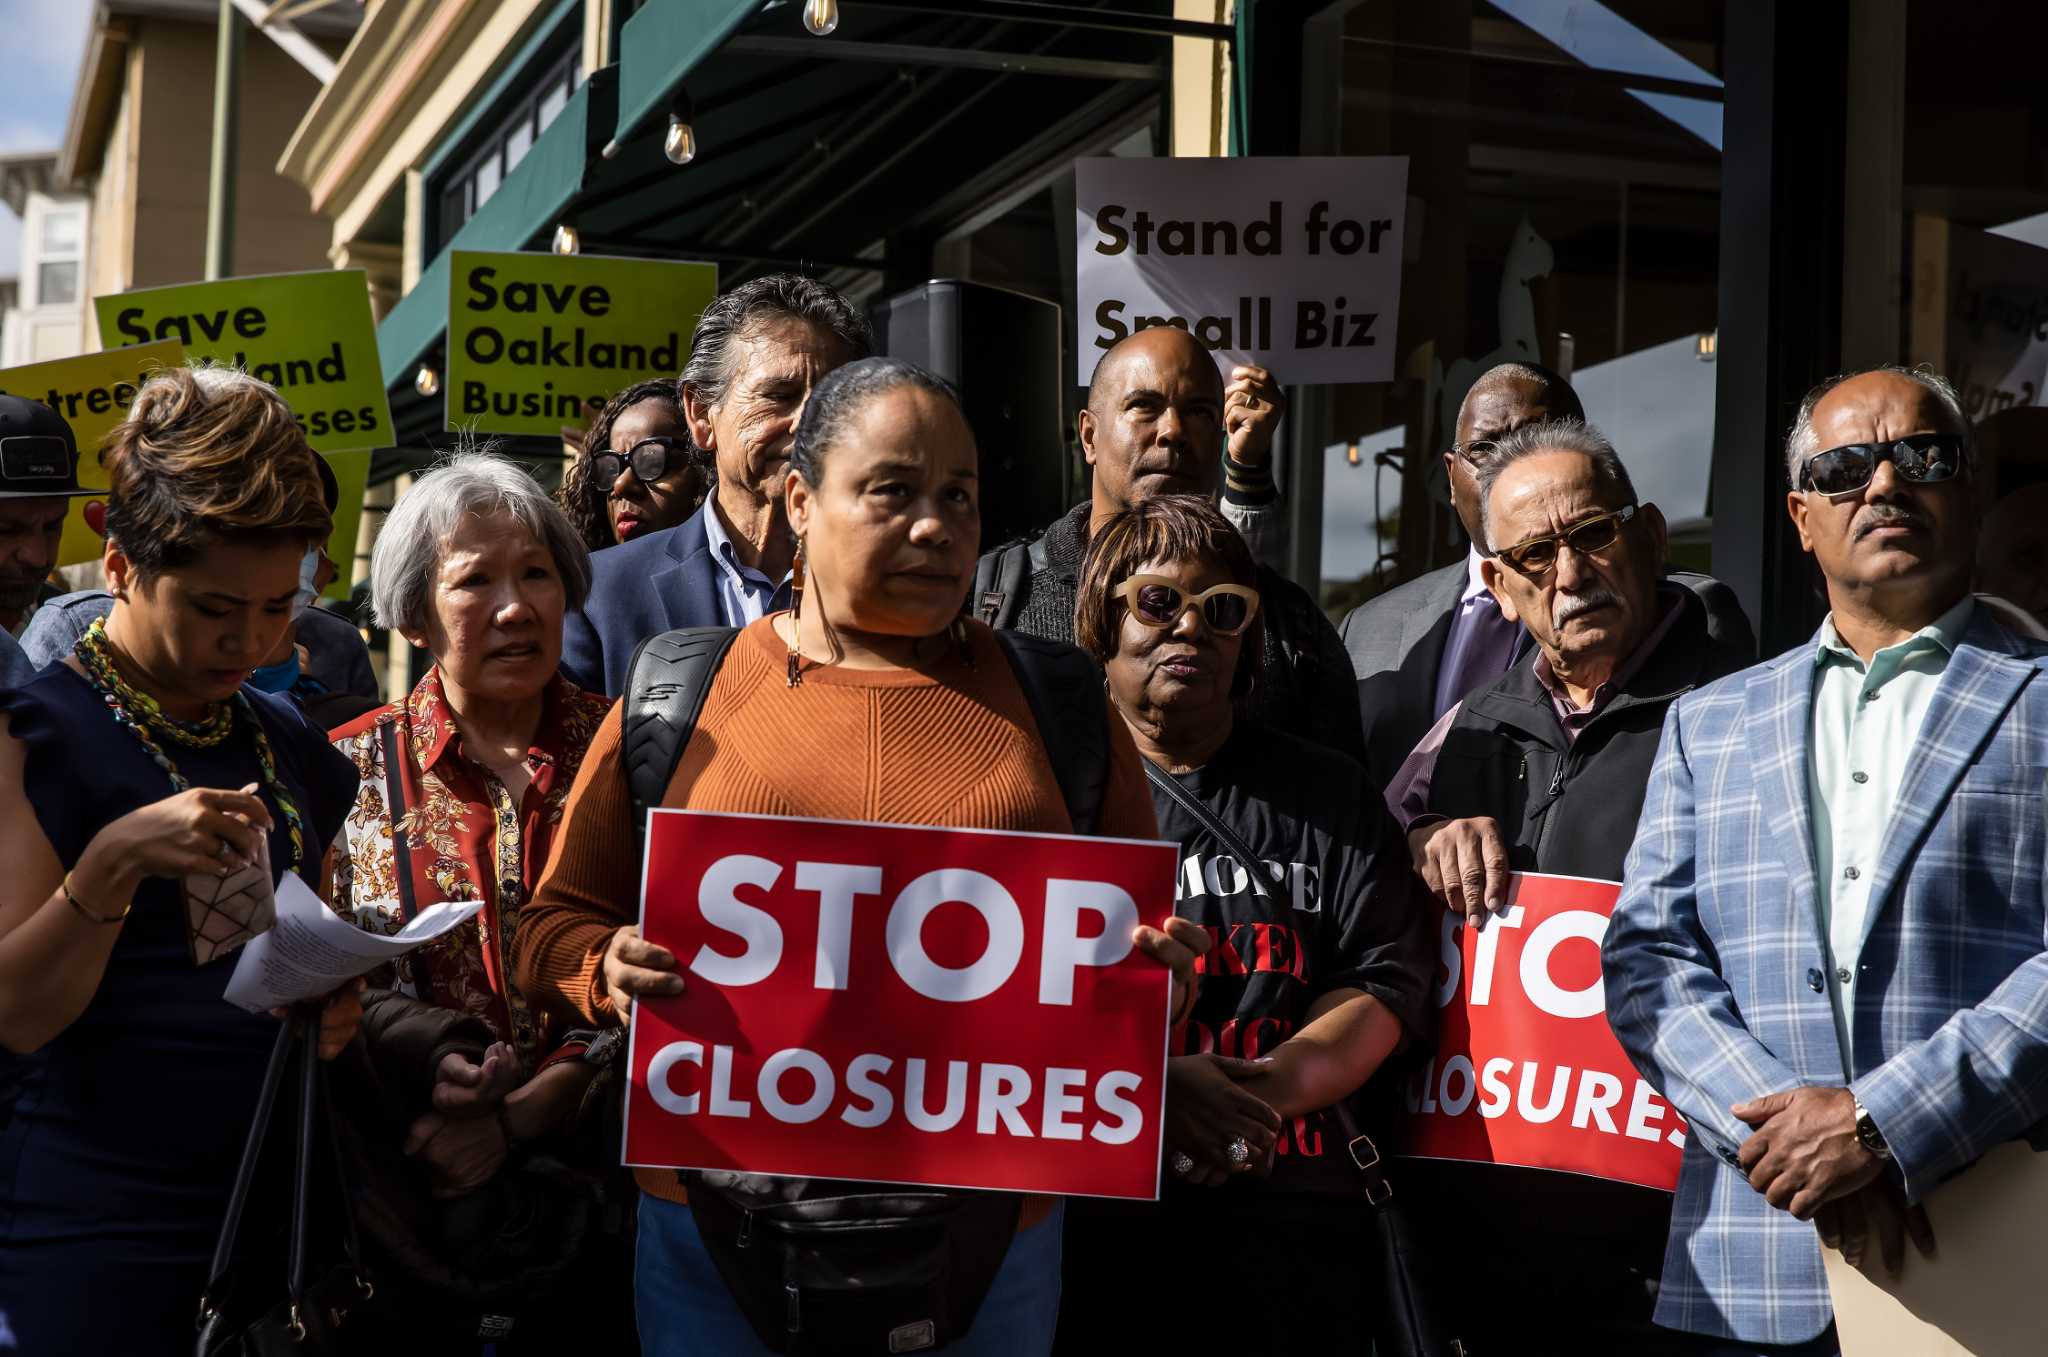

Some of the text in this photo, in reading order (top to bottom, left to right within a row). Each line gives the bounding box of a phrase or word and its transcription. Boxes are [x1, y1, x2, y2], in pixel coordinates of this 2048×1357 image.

[1095, 201, 1392, 256] Stand for
[466, 266, 611, 317] Save
[117, 306, 267, 347] Save
[465, 326, 679, 372] Oakland
[1295, 296, 1380, 350] Biz
[36, 373, 147, 418] tree
[689, 854, 1139, 1006] STOP
[1439, 904, 1608, 1019] STO
[647, 1041, 1143, 1145] CLOSURES
[1408, 1054, 1688, 1149] LOSURE
